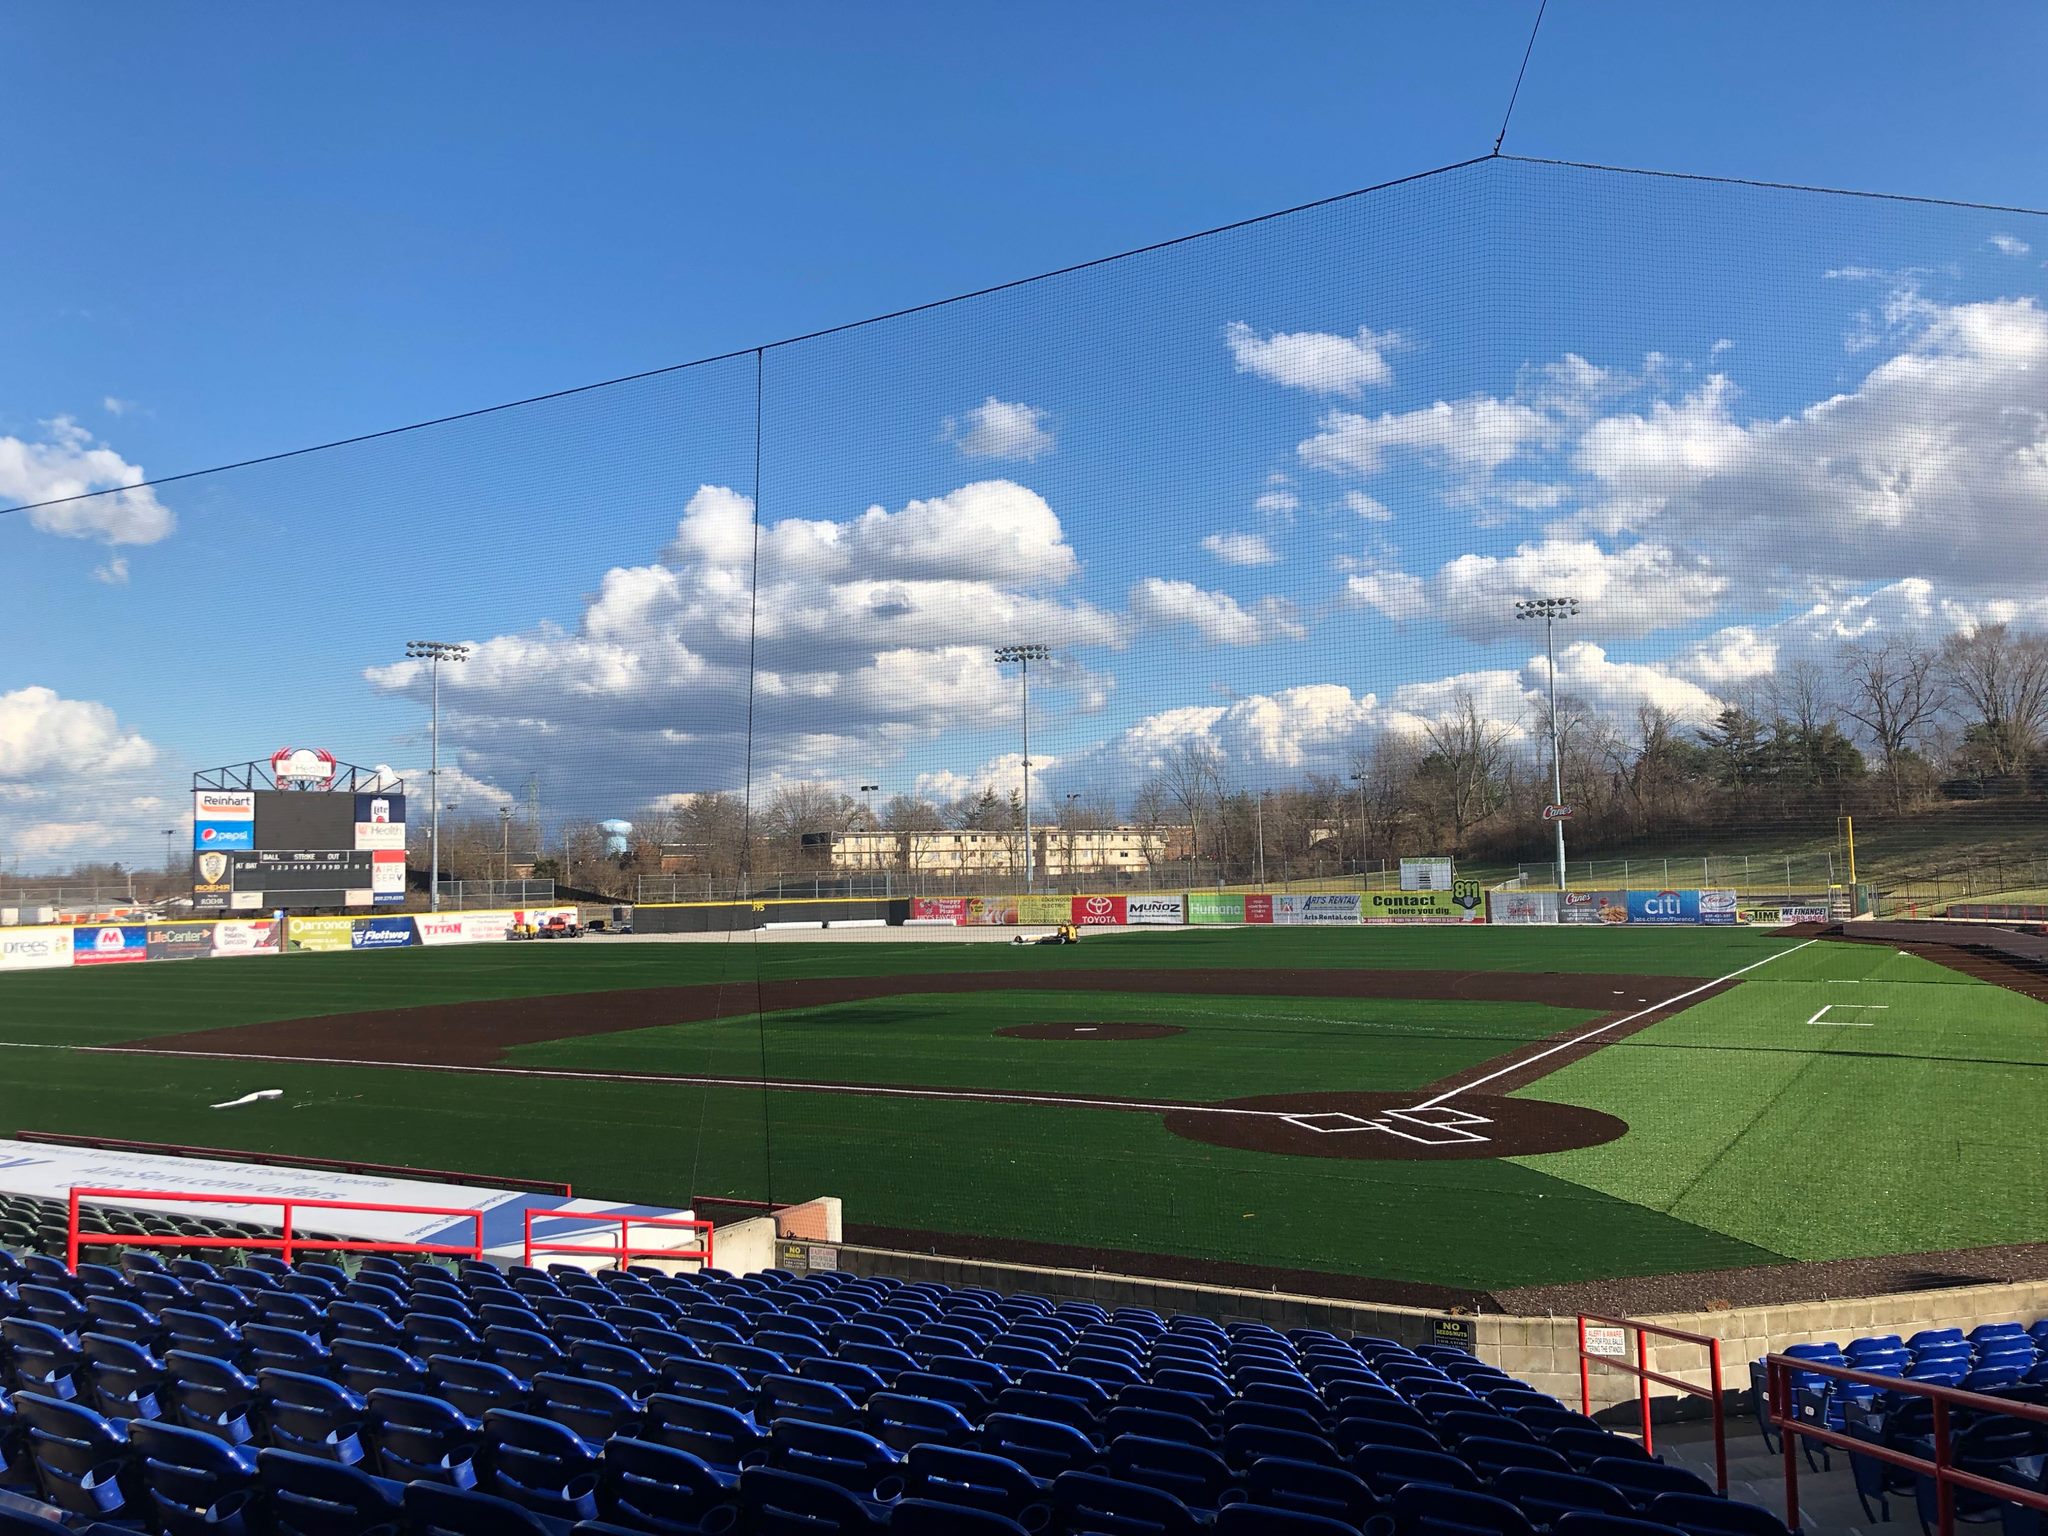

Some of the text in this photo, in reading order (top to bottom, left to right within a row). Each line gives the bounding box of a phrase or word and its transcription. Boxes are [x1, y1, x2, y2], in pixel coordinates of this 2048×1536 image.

[204, 796, 250, 806] Reinhart
[373, 806, 388, 815] Lite
[218, 832, 248, 843] pepsi
[294, 853, 316, 861] STRIKE
[1454, 881, 1480, 900] 811
[1328, 896, 1357, 905] RENTAL
[1373, 896, 1435, 906] Contact
[1566, 892, 1591, 905] Cane's
[1130, 901, 1181, 912] MUÑOZ
[1191, 903, 1241, 914] Humana
[1645, 894, 1681, 914] citi
[1388, 907, 1452, 917] before you dig.
[1794, 908, 1827, 916] FINANCE!
[1082, 916, 1117, 924] TOYOTA
[424, 923, 462, 935] TITAN
[148, 930, 203, 944] LifeCenter
[365, 930, 411, 940] Flottweg
[4, 941, 49, 954] Drees
[1442, 1322, 1460, 1331] NO
